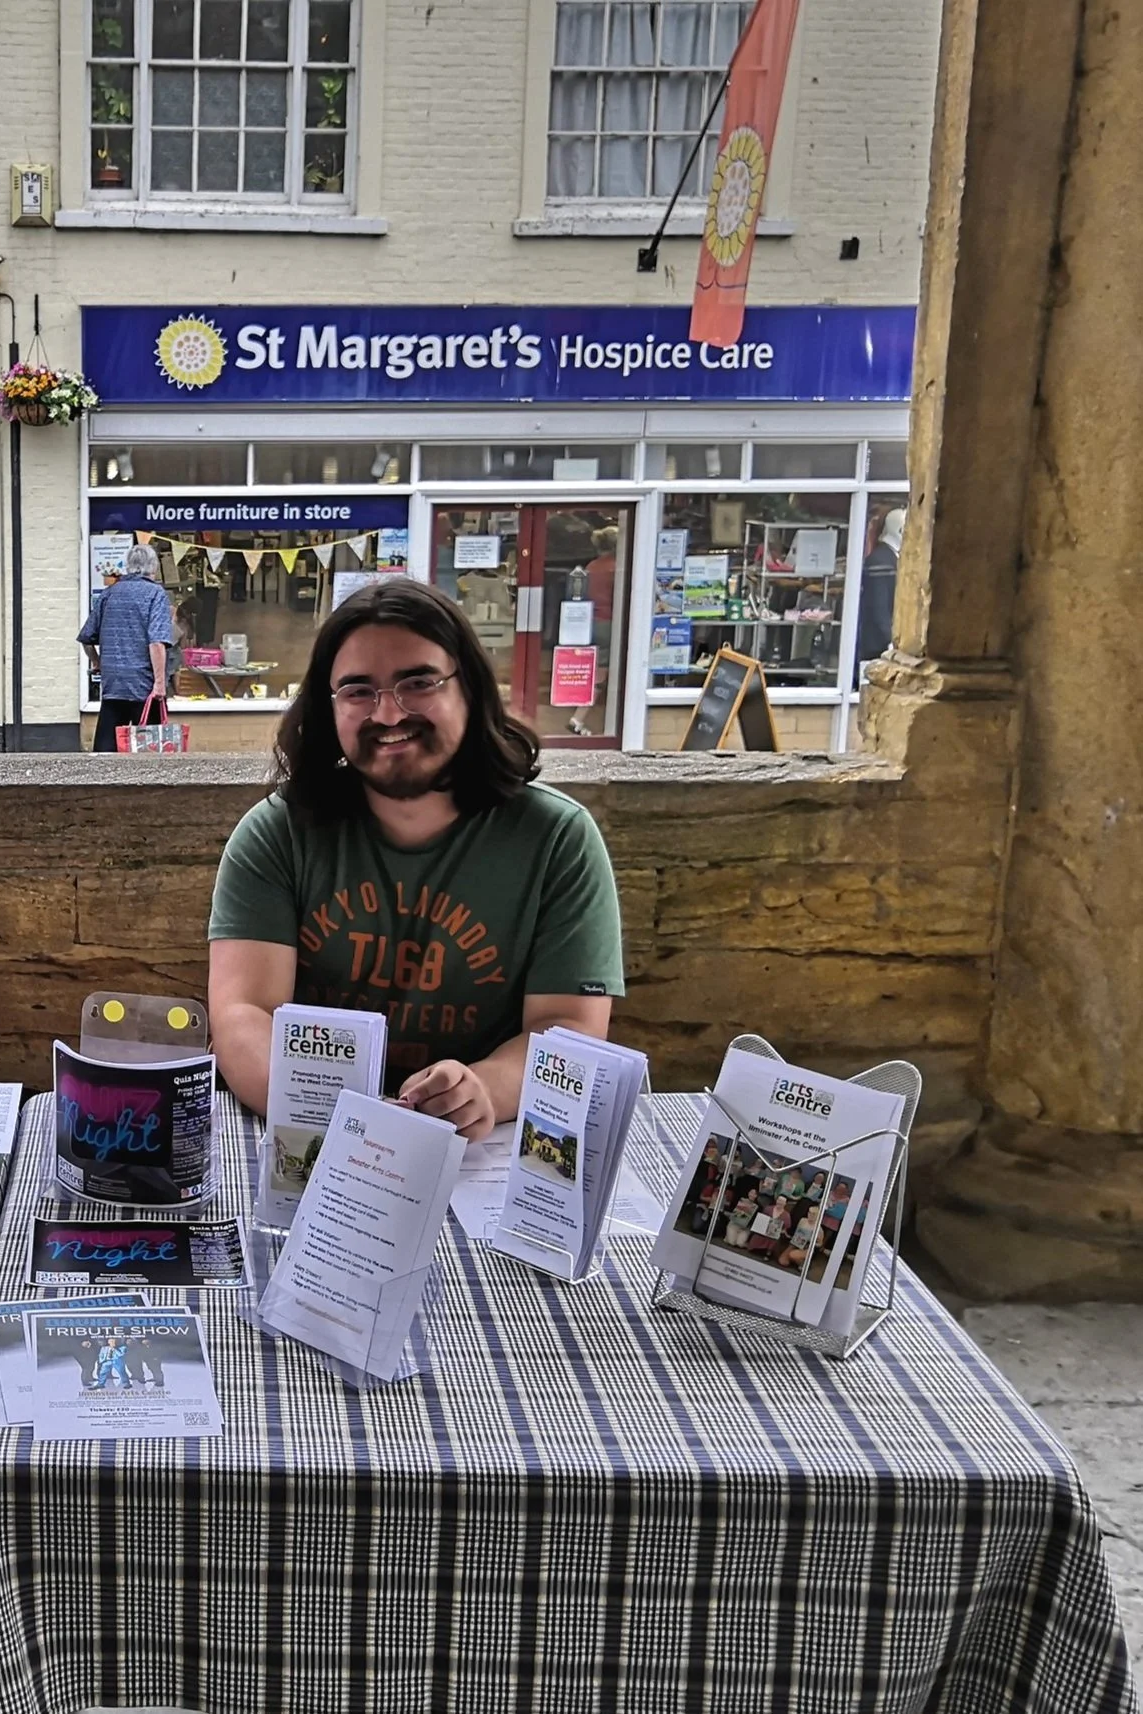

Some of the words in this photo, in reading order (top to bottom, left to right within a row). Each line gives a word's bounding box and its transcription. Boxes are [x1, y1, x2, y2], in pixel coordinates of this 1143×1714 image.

[235, 325, 286, 369] St
[559, 334, 692, 377] Hospice
[699, 341, 774, 369] Care
[146, 504, 194, 521] More
[198, 503, 279, 520] furniture
[283, 503, 300, 520] in
[304, 504, 351, 520] store
[396, 881, 505, 984] LAUNDRY
[290, 1024, 330, 1041] arts
[289, 1039, 355, 1059] centre
[538, 1049, 566, 1072] arts
[535, 1065, 582, 1095] centre
[779, 1079, 813, 1098] arts
[776, 1090, 831, 1115] centre
[758, 1116, 801, 1135] Workshops
[813, 1134, 826, 1143] the
[784, 1136, 800, 1146] Arts
[45, 1327, 125, 1336] TRIBUTE
[131, 1326, 189, 1335] SHOW
